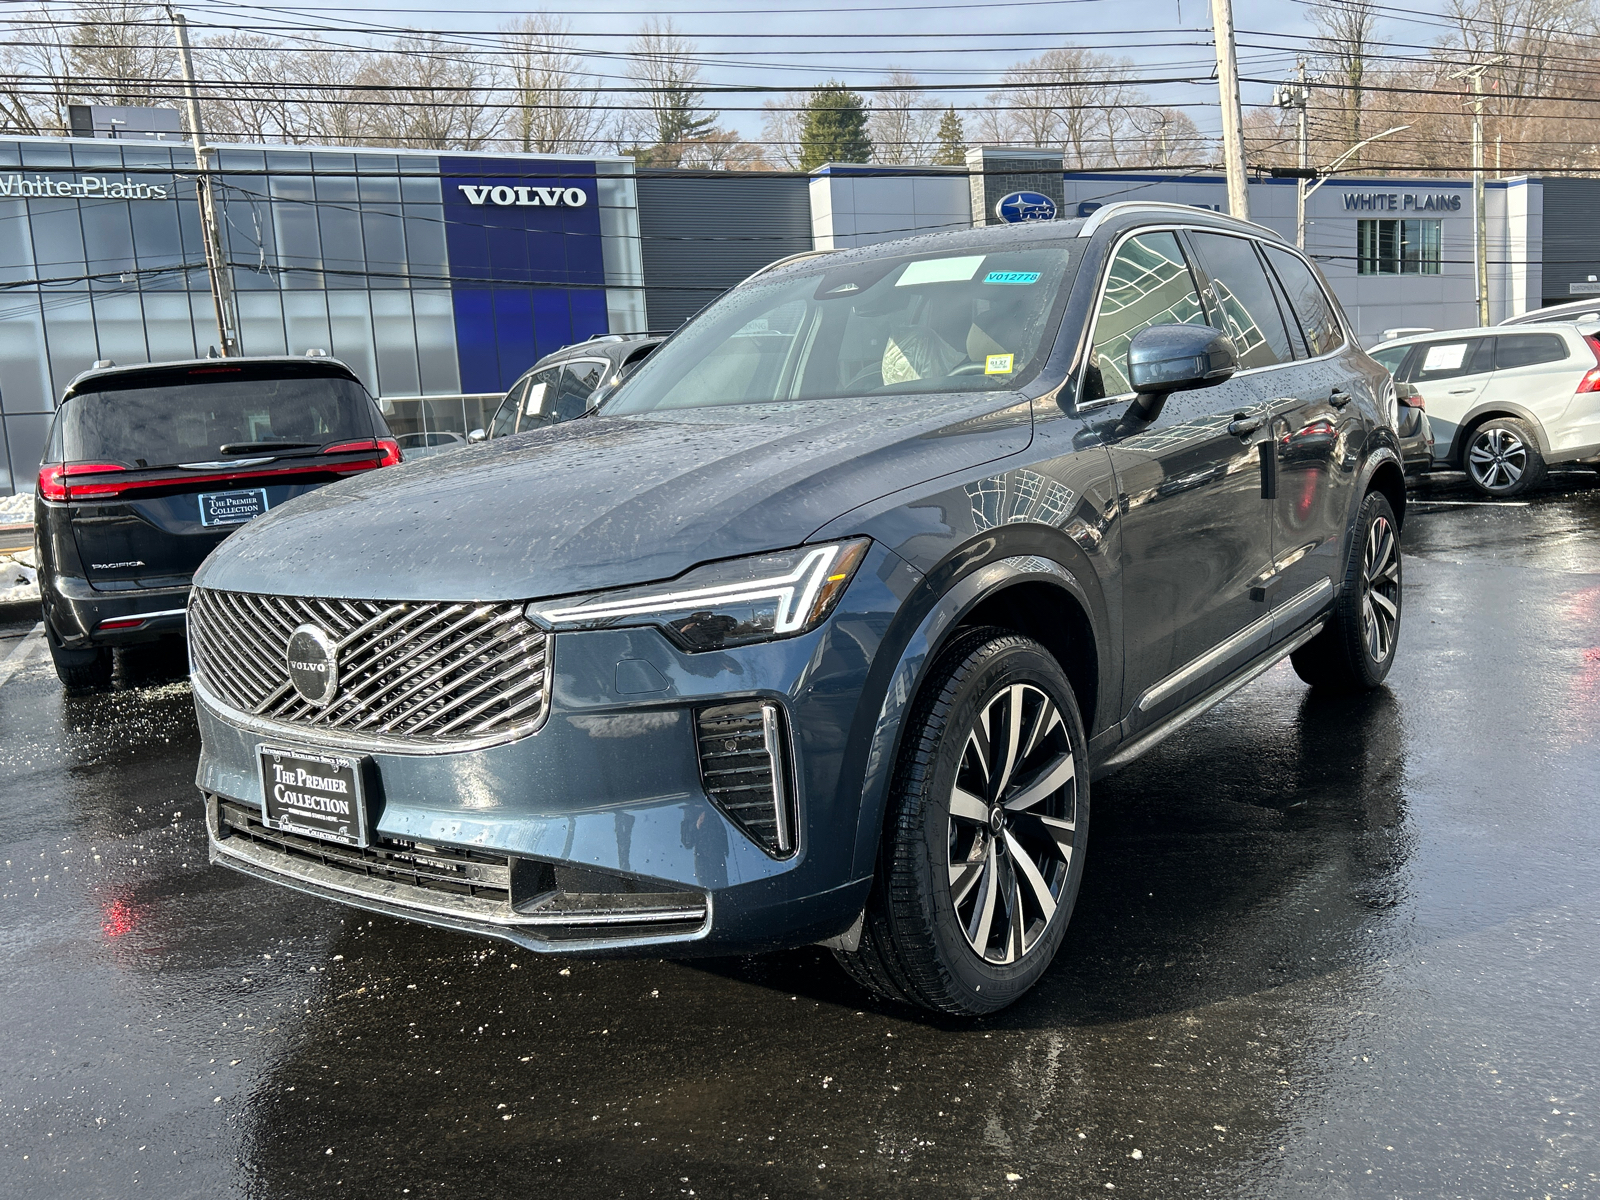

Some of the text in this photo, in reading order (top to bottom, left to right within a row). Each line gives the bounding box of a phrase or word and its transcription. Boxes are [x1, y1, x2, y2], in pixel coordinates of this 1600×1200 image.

[82, 176, 167, 199] Plains
[458, 184, 587, 207] VOLVO
[1342, 193, 1461, 212] WHITE PLAINS
[989, 273, 1038, 281] V012778
[209, 498, 258, 508] THE PREMIER
[210, 505, 259, 515] COLLECTION
[91, 560, 146, 570] PACIFICA
[290, 660, 325, 672] VOLVO
[273, 763, 348, 793] THE PREMIER
[274, 784, 350, 815] COLLECTION
